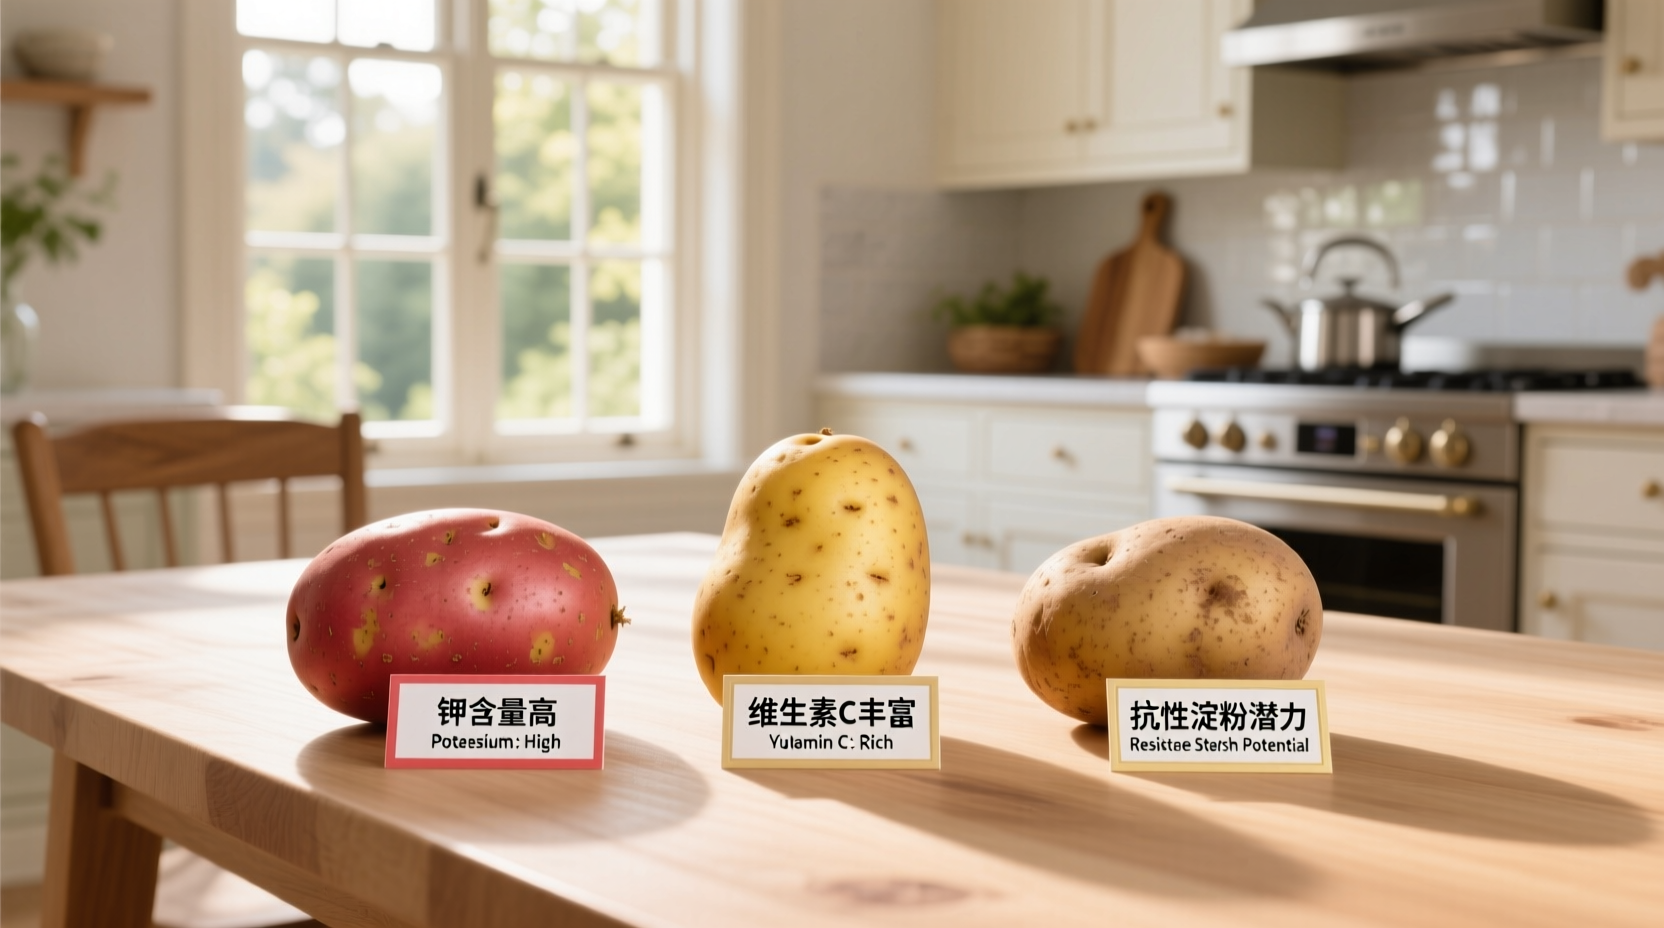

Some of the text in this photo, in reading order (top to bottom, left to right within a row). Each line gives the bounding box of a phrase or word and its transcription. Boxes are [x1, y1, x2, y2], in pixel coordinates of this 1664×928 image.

[437, 696, 558, 727] 钾含量高
[747, 696, 916, 728] 维生素C丰富
[1129, 699, 1306, 731] 抗性淀粉潜力
[524, 733, 561, 754] High
[859, 733, 894, 750] Rich
[1243, 736, 1309, 752] Potential
